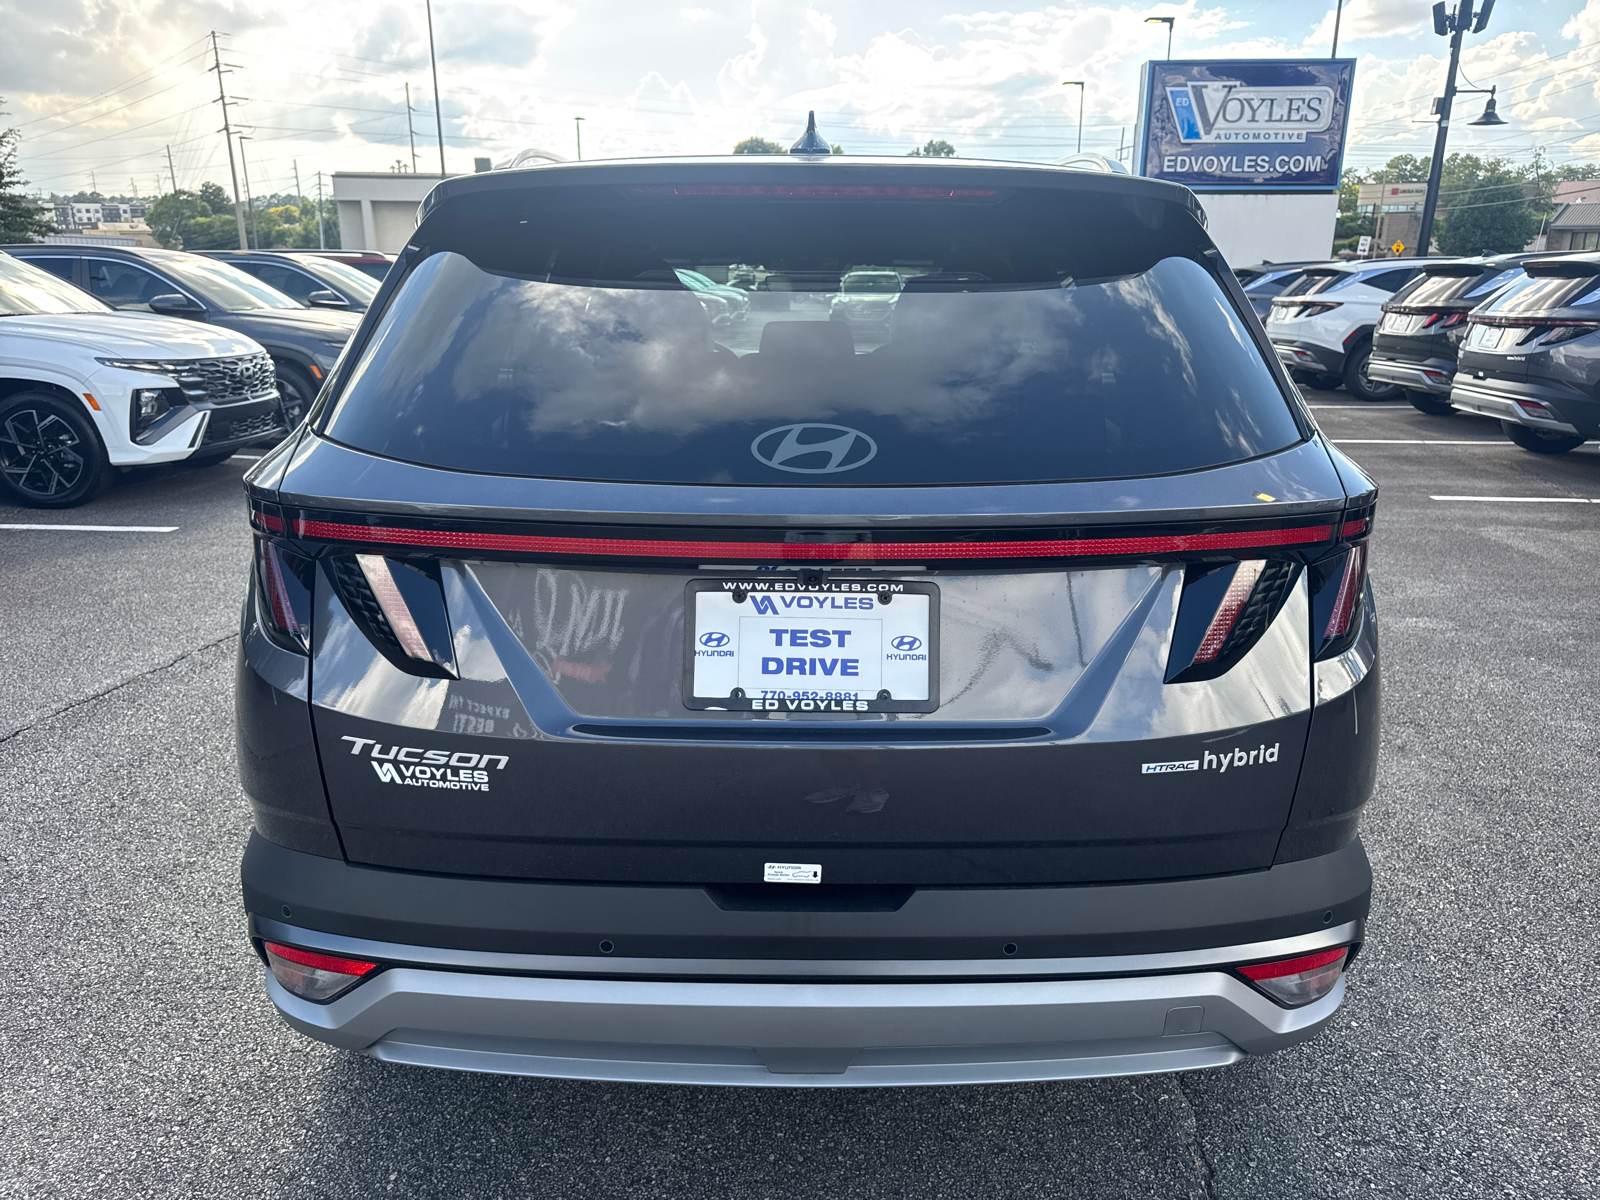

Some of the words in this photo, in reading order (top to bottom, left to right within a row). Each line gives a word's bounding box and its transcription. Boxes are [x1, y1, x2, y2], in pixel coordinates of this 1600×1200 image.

[1175, 97, 1189, 107] ED
[1190, 84, 1322, 135] VOYLES
[1214, 132, 1304, 140] AUTOMOTIVE
[1162, 155, 1322, 173] EDVOYLES.COM
[722, 582, 904, 592] WWW.EDVOYLES.COM
[779, 595, 874, 610] VOYLES
[769, 628, 852, 648] TEST
[886, 653, 927, 661] HYUNDAI
[761, 657, 859, 677] DRIVE
[760, 690, 859, 700] 770-952-8881
[751, 700, 779, 710] ED
[785, 700, 869, 711] VOYLES
[1145, 762, 1195, 772] HTRAC
[1202, 743, 1280, 773] hybrid
[399, 763, 489, 783] VOYLES
[403, 777, 490, 792] AUTOMOTIVE
